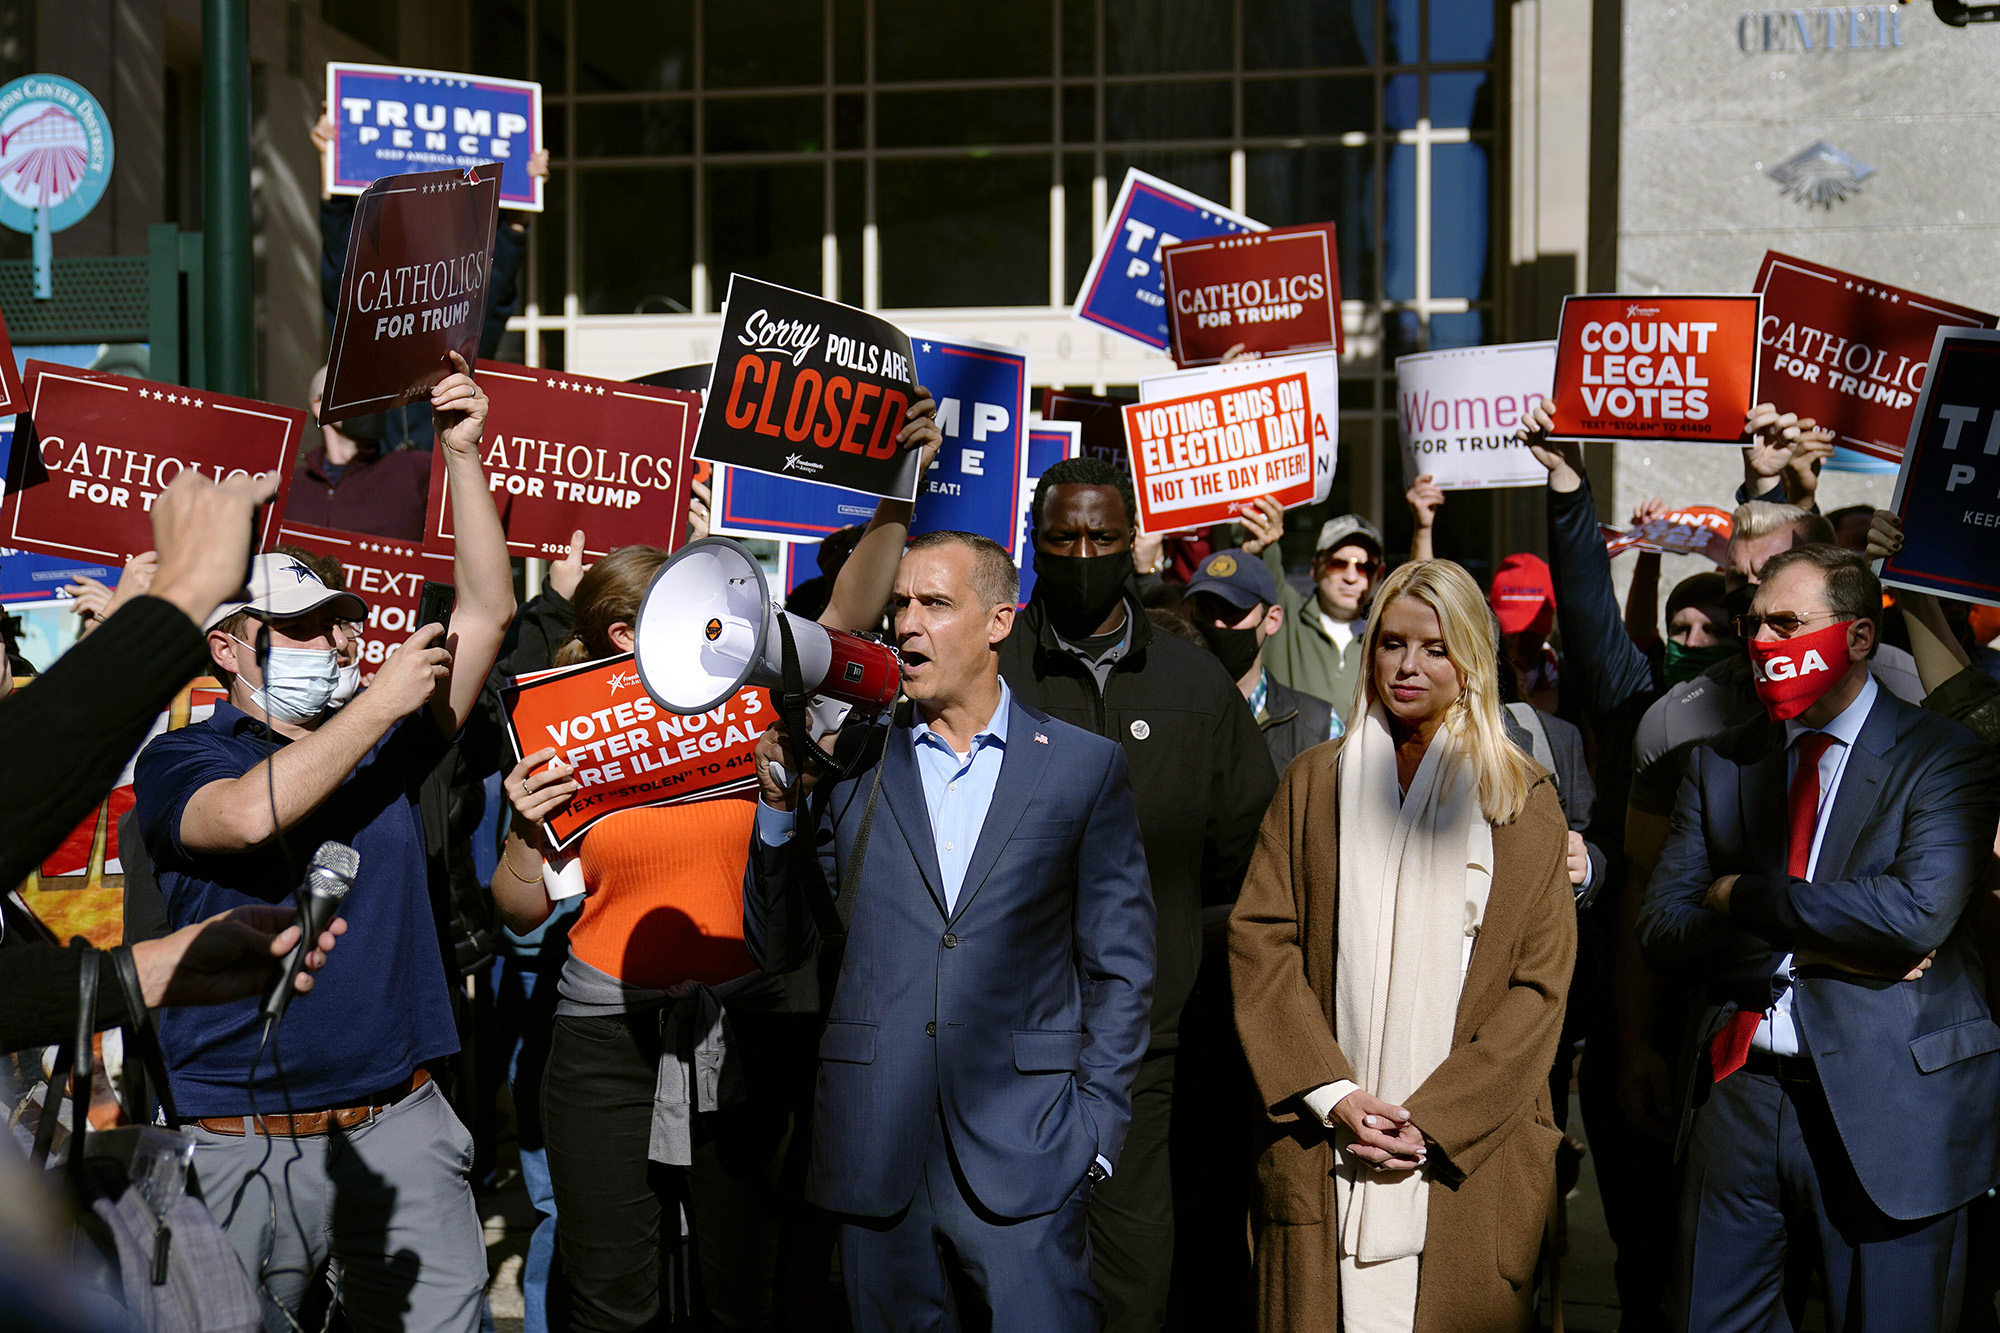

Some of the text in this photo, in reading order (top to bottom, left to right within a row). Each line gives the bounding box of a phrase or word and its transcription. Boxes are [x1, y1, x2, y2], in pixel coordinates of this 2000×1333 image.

[1738, 5, 1904, 51] CENTER
[341, 97, 527, 139] TRUMP
[359, 126, 511, 158] PENCE
[375, 149, 405, 160] KEEP
[405, 151, 455, 166] AMERICA
[357, 251, 484, 313] CATHOLICS
[1177, 273, 1324, 314] CATHOLICS
[374, 300, 470, 341] FOR TRUMP
[1198, 303, 1303, 329] FOR TRUMP
[737, 309, 820, 366] Sorry
[825, 333, 878, 374] POLLS
[881, 349, 911, 384] ARE
[1581, 321, 1717, 354] COUNT
[1760, 315, 1928, 393] CATHOLIC
[1582, 354, 1709, 387] LEGAL
[1774, 353, 1913, 410] FOR TRUMP
[403, 385, 427, 398] 2020
[725, 354, 909, 460] CLOSED
[1135, 379, 1304, 440] VOTING ENDS ON
[1580, 387, 1709, 420] VOTES
[1141, 420, 1262, 475] ELECTION
[1264, 409, 1306, 452] DAY
[1414, 435, 1528, 455] FOR TRUM
[1580, 420, 1606, 430] TEXT
[1664, 422, 1677, 432] TO
[480, 434, 672, 490] ATHOLICS
[1152, 479, 1184, 504] NOT
[1190, 472, 1223, 497] THE
[1228, 465, 1260, 490] DAY
[1265, 452, 1307, 483] AFTER!
[68, 479, 130, 509] FOR
[489, 472, 641, 509] FOR TRUMP
[927, 481, 961, 496] EAT!
[541, 543, 571, 554] 2020
[342, 563, 425, 598] TEXT
[368, 604, 416, 633] HOL
[1752, 649, 1829, 682] AGA
[545, 697, 656, 747] VOTES
[656, 702, 737, 742] NOV.
[740, 690, 762, 714] 3
[629, 719, 766, 774] ILLEGAL
[563, 793, 605, 818] TEXT
[697, 762, 721, 777] TO
[725, 752, 756, 769] 414
